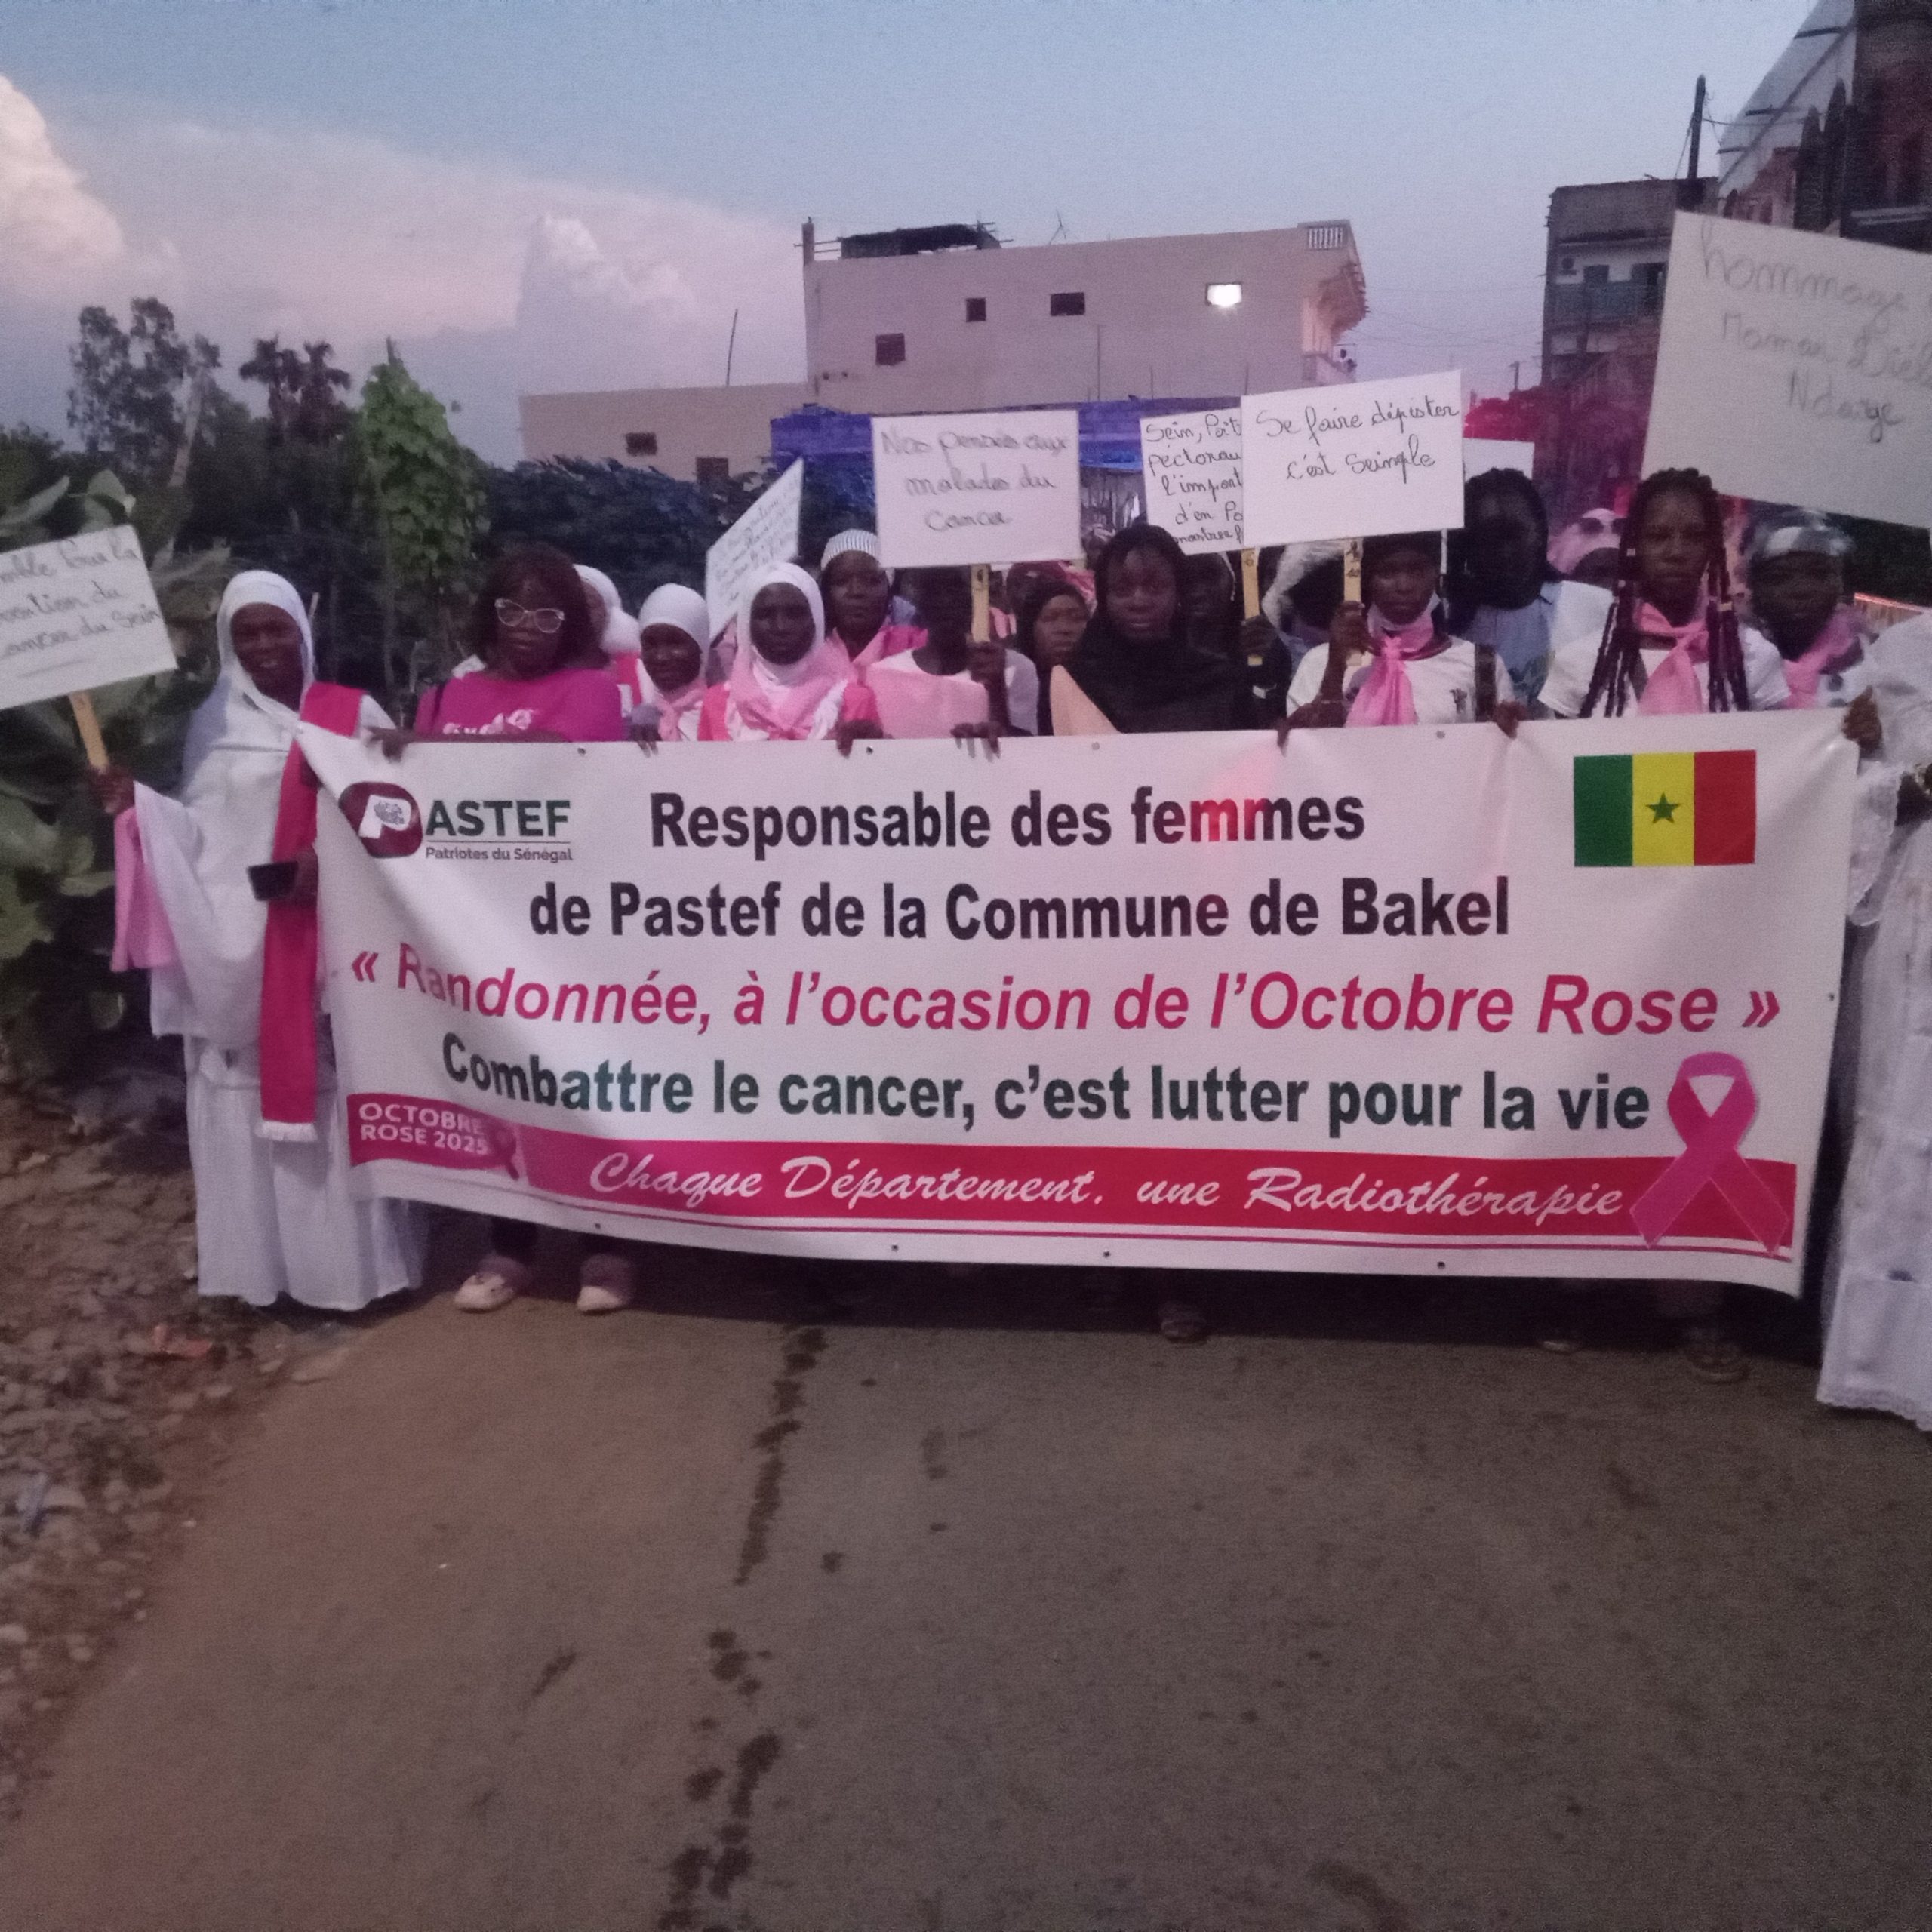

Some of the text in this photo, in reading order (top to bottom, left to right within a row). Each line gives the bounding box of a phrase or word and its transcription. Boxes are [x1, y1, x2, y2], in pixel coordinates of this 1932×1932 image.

[1303, 405, 1363, 447] faire
[426, 846, 574, 864] Patriotes du Sénégal
[651, 786, 1366, 862] Responsable des femmes
[529, 875, 1509, 941] de Pastef de la Commune de Bakel
[398, 943, 711, 1036] Randonnée,
[734, 970, 764, 1026] à
[1113, 973, 1190, 1031] de
[1536, 974, 1720, 1038] Rose
[358, 1102, 485, 1135] OCTOBRE
[442, 1031, 693, 1115] Combattre
[714, 1060, 759, 1115] le
[778, 1073, 974, 1132] cancer,
[1151, 1064, 1309, 1124] lutter
[1328, 1080, 1463, 1140] pour
[1483, 1070, 1536, 1132] la
[1557, 1072, 1651, 1131] vie
[360, 1124, 489, 1156] ROSE 2025
[589, 1152, 763, 1204] Chaque
[1136, 1179, 1220, 1208] une
[1244, 1166, 1624, 1224] Radiothérapie
